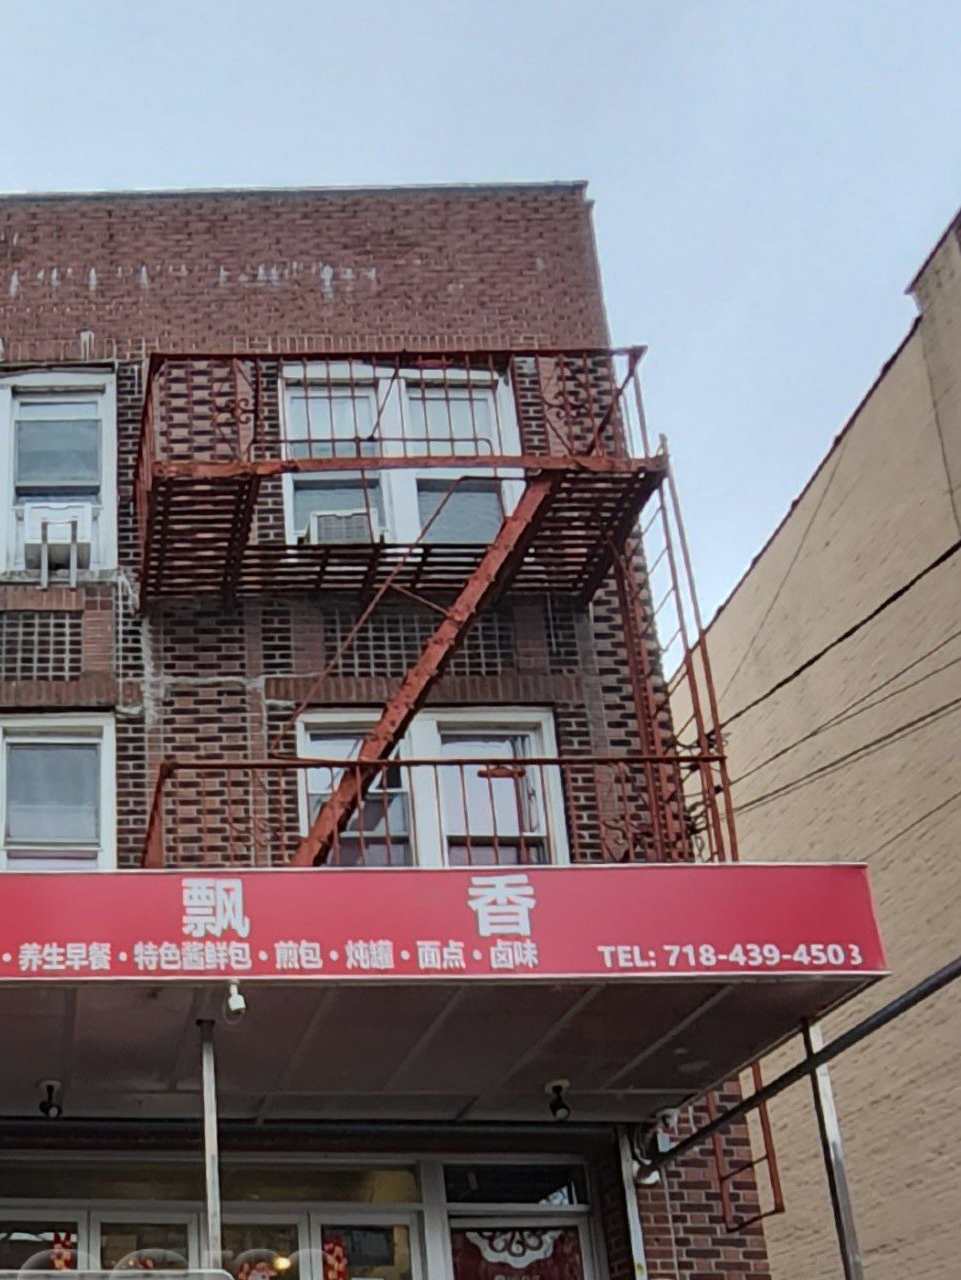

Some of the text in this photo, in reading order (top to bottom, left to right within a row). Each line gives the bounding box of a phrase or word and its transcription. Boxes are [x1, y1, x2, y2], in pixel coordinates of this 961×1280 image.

[18, 942, 112, 972] 养生早餐
[415, 940, 467, 970] 面点
[489, 938, 539, 970] 卤味
[596, 943, 864, 969] TEL: 718-439-4503
